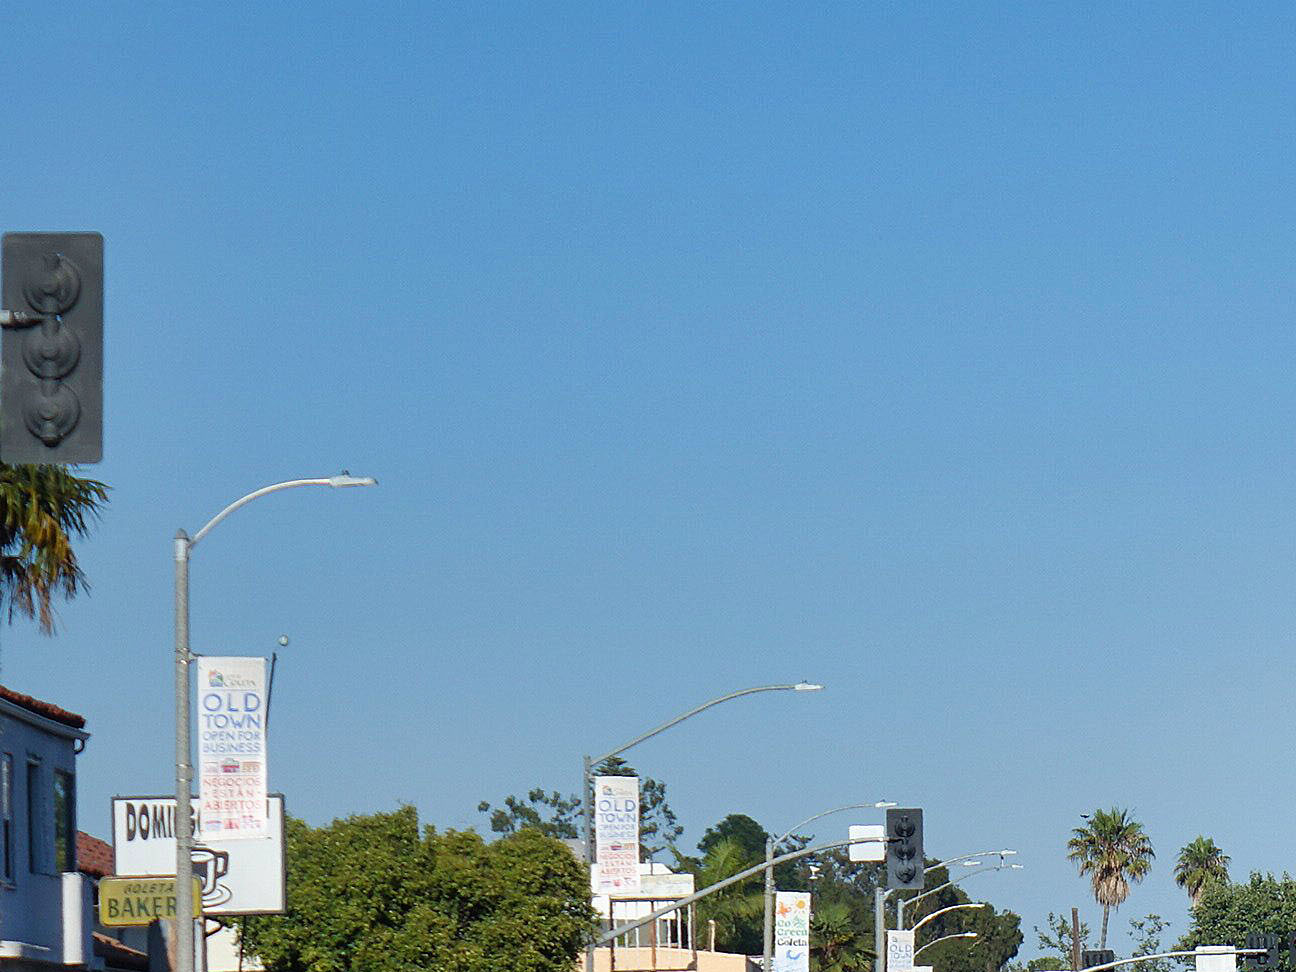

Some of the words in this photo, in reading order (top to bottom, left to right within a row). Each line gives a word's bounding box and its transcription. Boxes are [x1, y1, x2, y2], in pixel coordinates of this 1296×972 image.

[203, 692, 261, 712] OLD
[202, 713, 261, 729] TOWN
[203, 730, 235, 741] OPEN
[239, 730, 261, 741] FOR
[203, 742, 261, 753] BUSINESS
[599, 800, 636, 812] OLD
[599, 813, 636, 822] TOWN
[108, 896, 177, 918] BAKER
[777, 928, 808, 936] Green
[777, 938, 808, 947] Goleta
[890, 944, 912, 953] OLD
